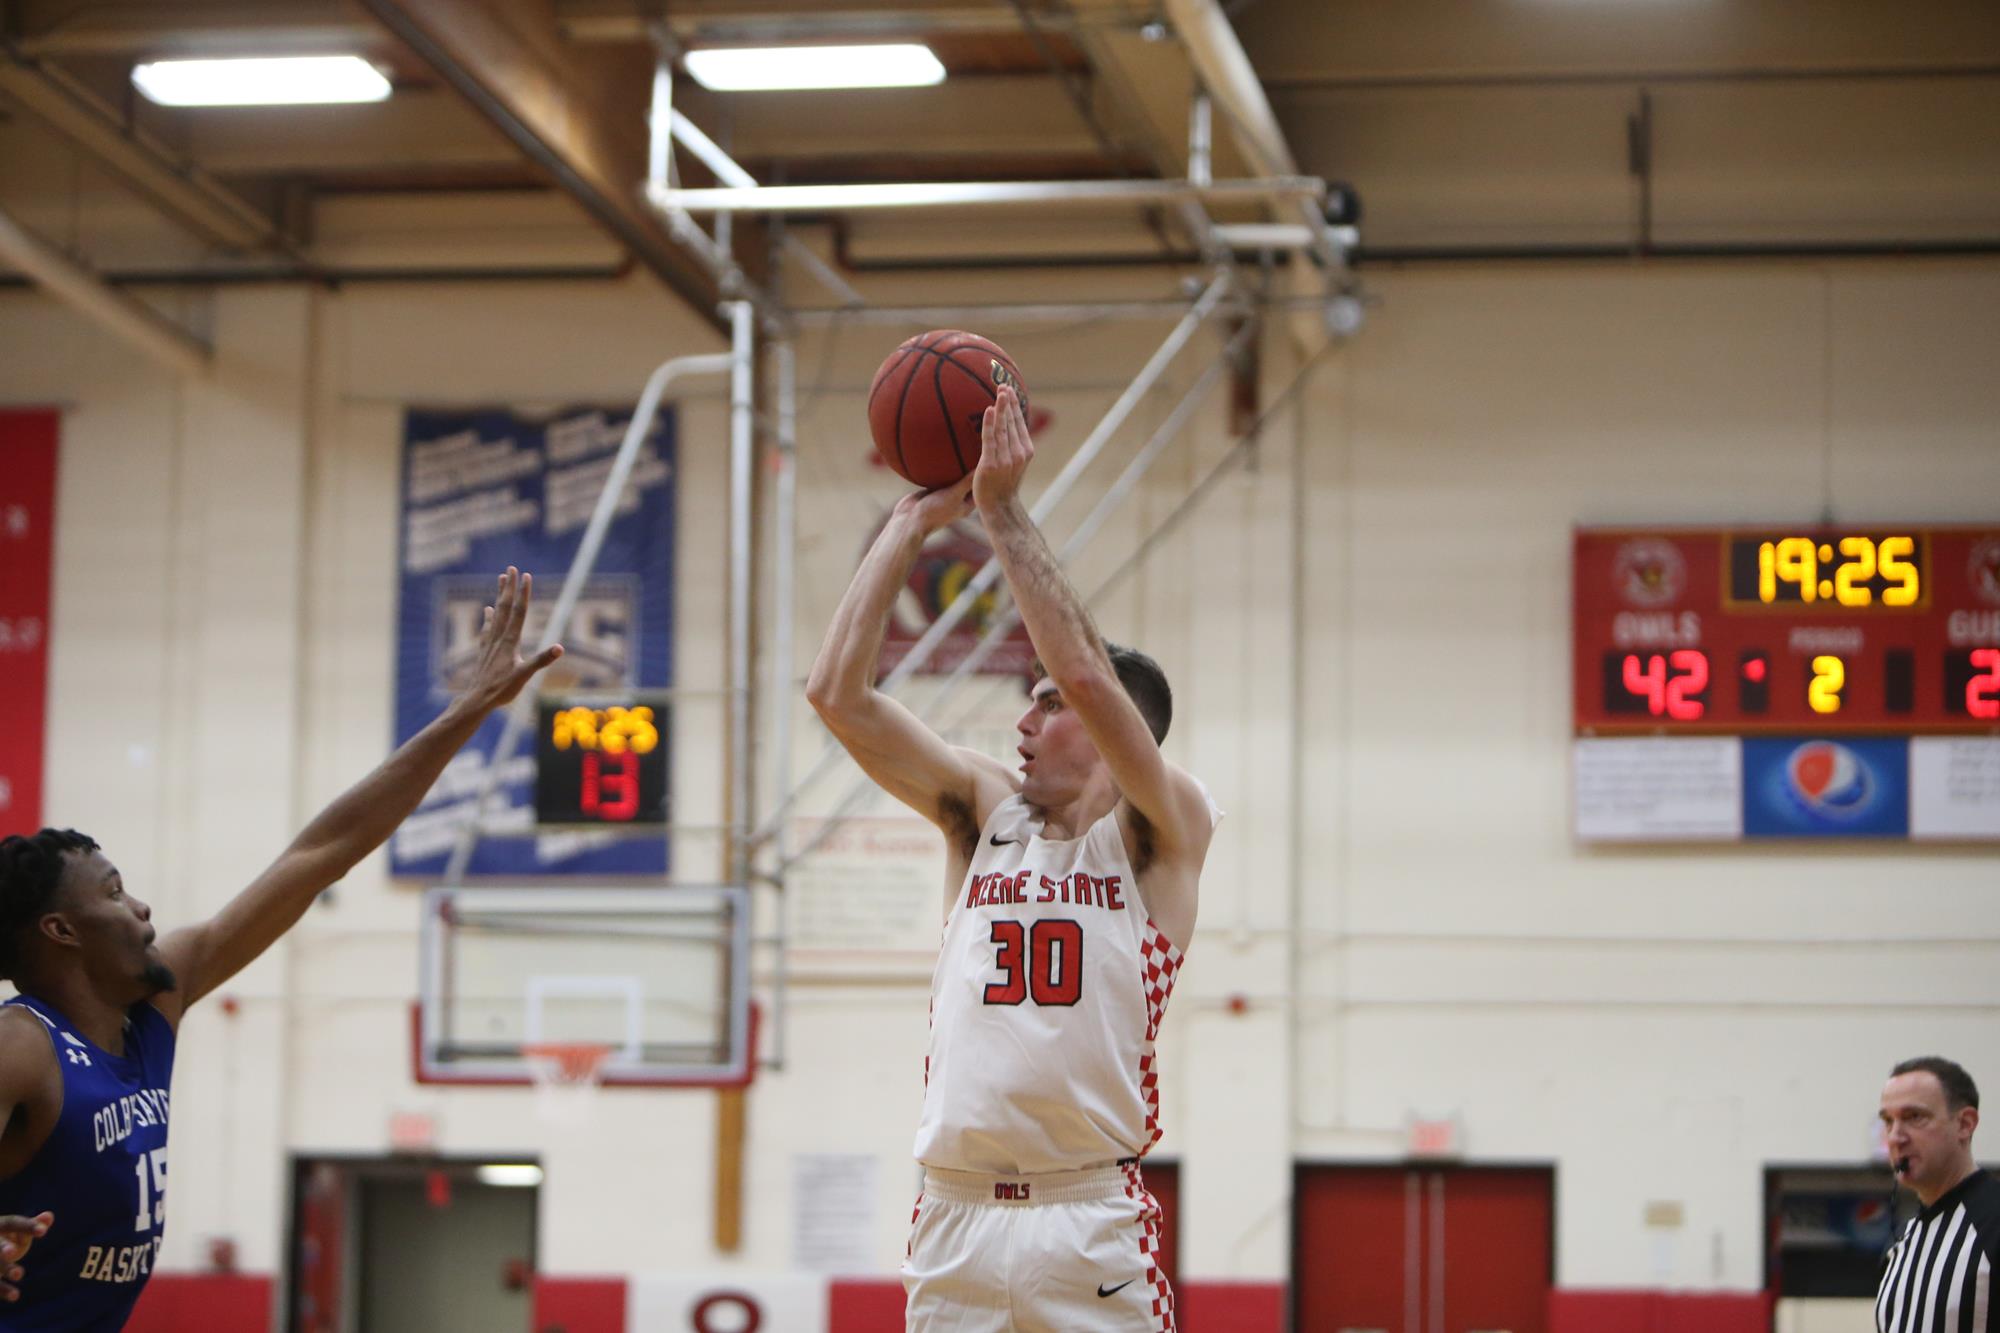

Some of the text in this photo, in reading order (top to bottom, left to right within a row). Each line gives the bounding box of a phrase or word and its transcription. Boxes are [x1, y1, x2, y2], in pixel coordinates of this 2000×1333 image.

[1759, 537, 1919, 606] 19:25
[1622, 650, 1708, 720] 42
[1809, 656, 1844, 713] 2
[1966, 649, 2000, 718] 2
[966, 870, 1032, 909] KEENE
[1036, 872, 1125, 910] STATE
[983, 919, 1083, 1006] 30
[135, 1147, 167, 1232] 15
[994, 1183, 1030, 1200] OWLS
